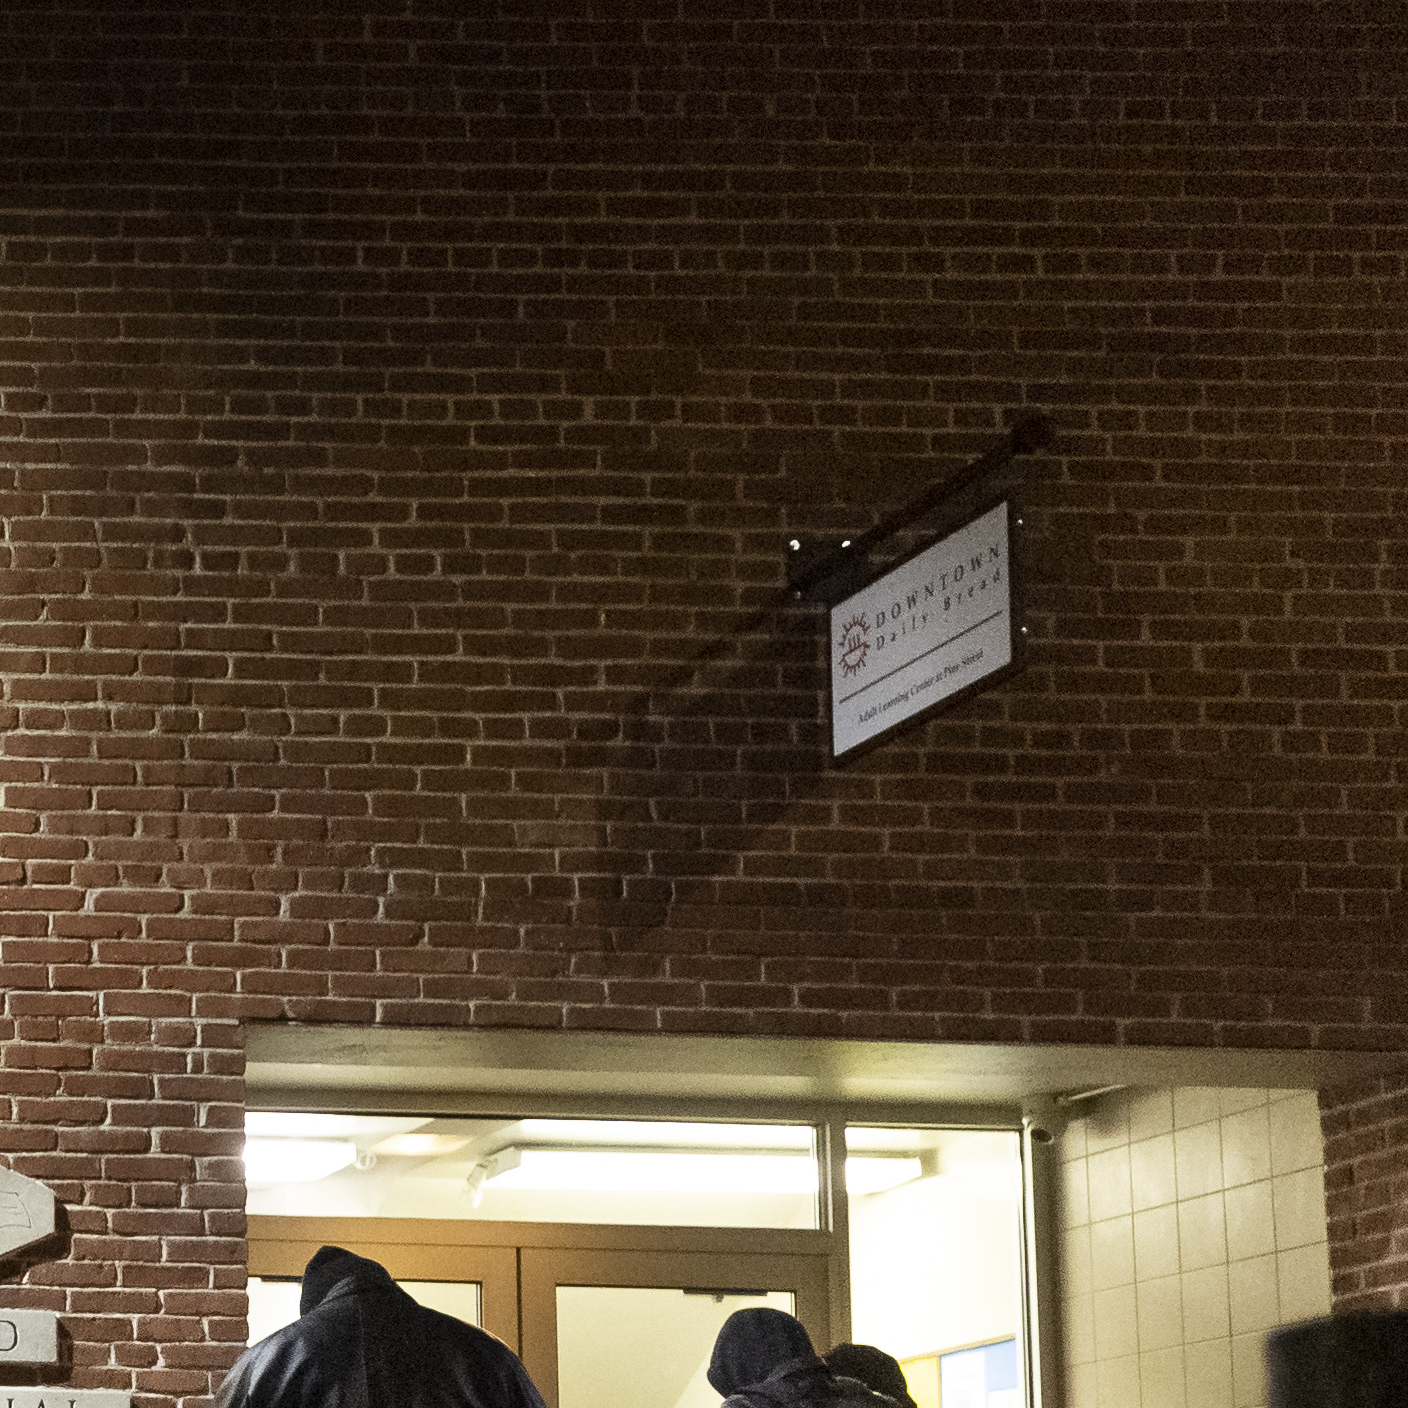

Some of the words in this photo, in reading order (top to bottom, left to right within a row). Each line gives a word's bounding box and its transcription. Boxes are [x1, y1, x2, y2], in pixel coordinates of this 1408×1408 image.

[876, 543, 1001, 629] DOWNTOWN
[876, 613, 928, 650] Daily
[943, 567, 1001, 611] Bread
